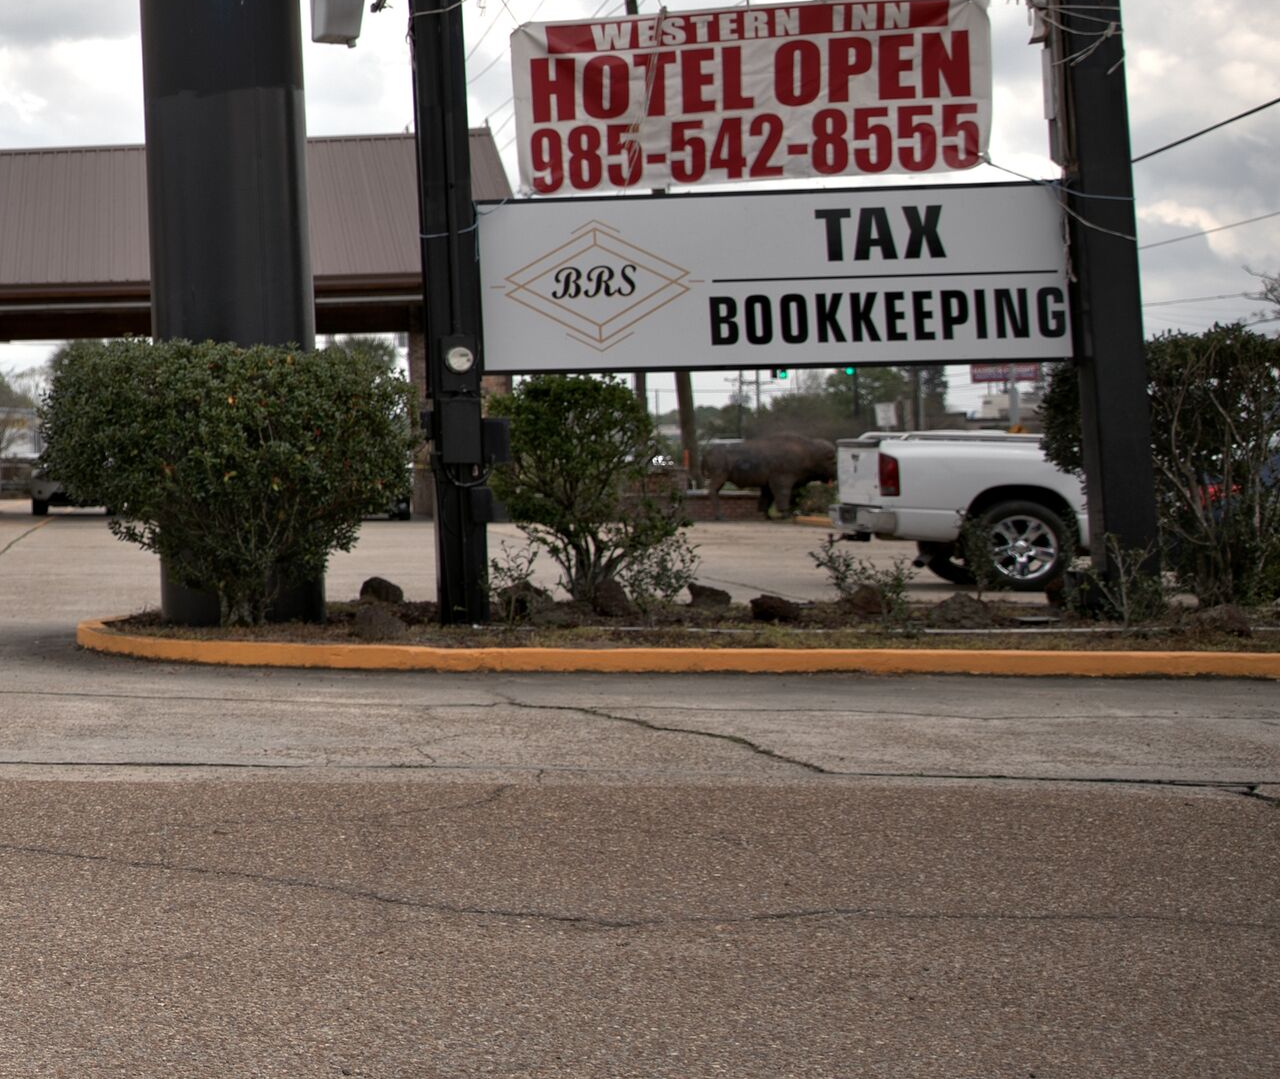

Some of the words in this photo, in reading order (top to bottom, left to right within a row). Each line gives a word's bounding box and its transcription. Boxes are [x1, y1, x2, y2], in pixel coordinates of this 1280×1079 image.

[590, 7, 801, 51] WESTERN
[831, 2, 911, 32] INN
[530, 46, 755, 123] HOTEL
[773, 30, 971, 107] OPEN
[530, 103, 981, 194] 985-542-8555
[815, 204, 947, 262] TAX
[552, 264, 637, 299] BRS
[708, 285, 1066, 347] BOOKKEEPING
